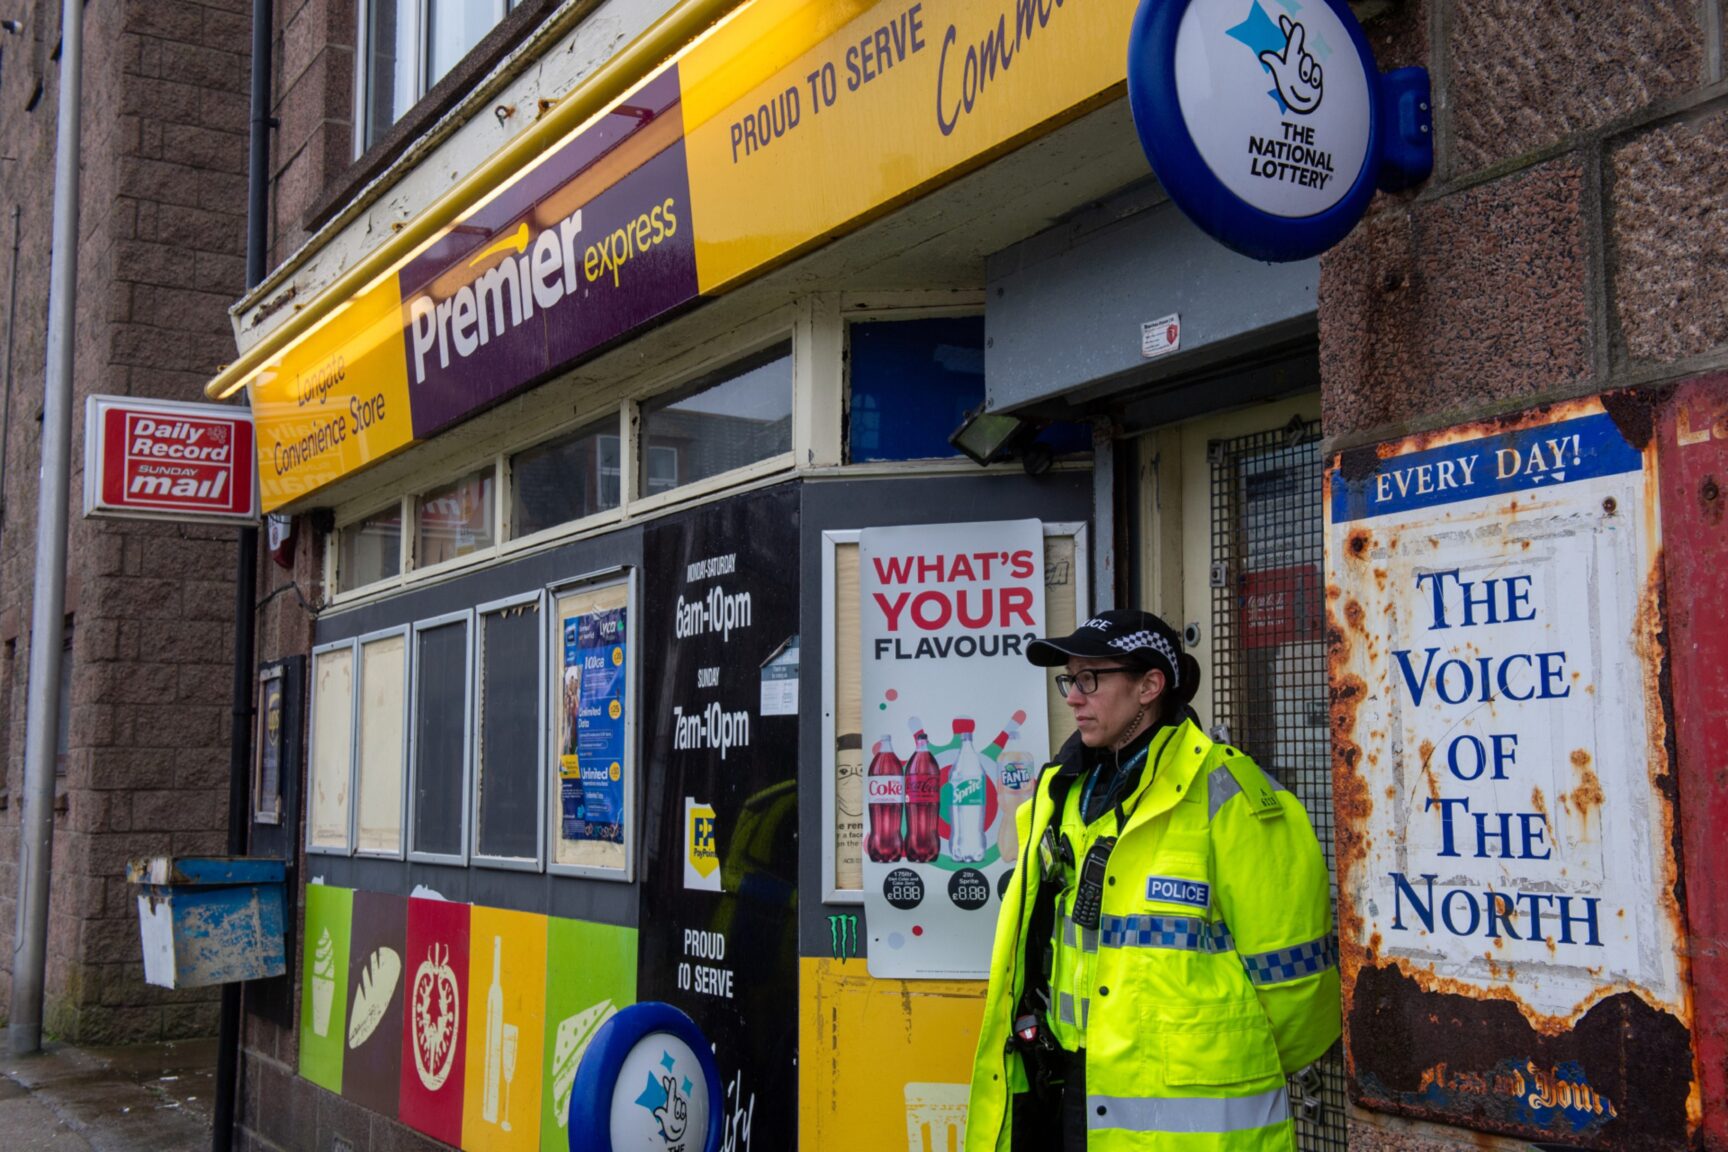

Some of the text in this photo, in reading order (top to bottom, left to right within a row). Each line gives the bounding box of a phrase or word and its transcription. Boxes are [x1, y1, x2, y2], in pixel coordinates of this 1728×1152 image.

[730, 3, 926, 164] PROUD TO SERVE
[936, 0, 1065, 137] Comm
[1248, 135, 1334, 172] NATIONAL
[1281, 121, 1315, 146] THE
[1250, 157, 1330, 190] LOTTERY
[410, 198, 677, 385] Premier express
[296, 355, 346, 407] Longate
[131, 438, 229, 462] Record
[133, 420, 205, 443] Daily
[274, 392, 386, 476] Convenience Store
[129, 470, 229, 499] mail
[137, 465, 199, 476] SUNDAY
[1374, 434, 1582, 503] EVERY DAY!
[686, 552, 737, 583] MONDAY-SATURDAY
[676, 585, 751, 642] 6am-10pm
[872, 586, 1036, 632] YOUR
[1416, 568, 1537, 631] THE
[697, 667, 720, 688] SUNDAY
[1391, 647, 1571, 707] VOICE
[673, 701, 749, 760] 7am-10pm
[1447, 733, 1519, 781] OF
[869, 780, 903, 796] Coke
[953, 779, 981, 804] Sprite
[1424, 796, 1552, 861] THE
[1151, 881, 1206, 902] POLICE
[1387, 871, 1605, 947] NORTH
[684, 928, 725, 960] PROUD
[694, 963, 734, 999] SERVE
